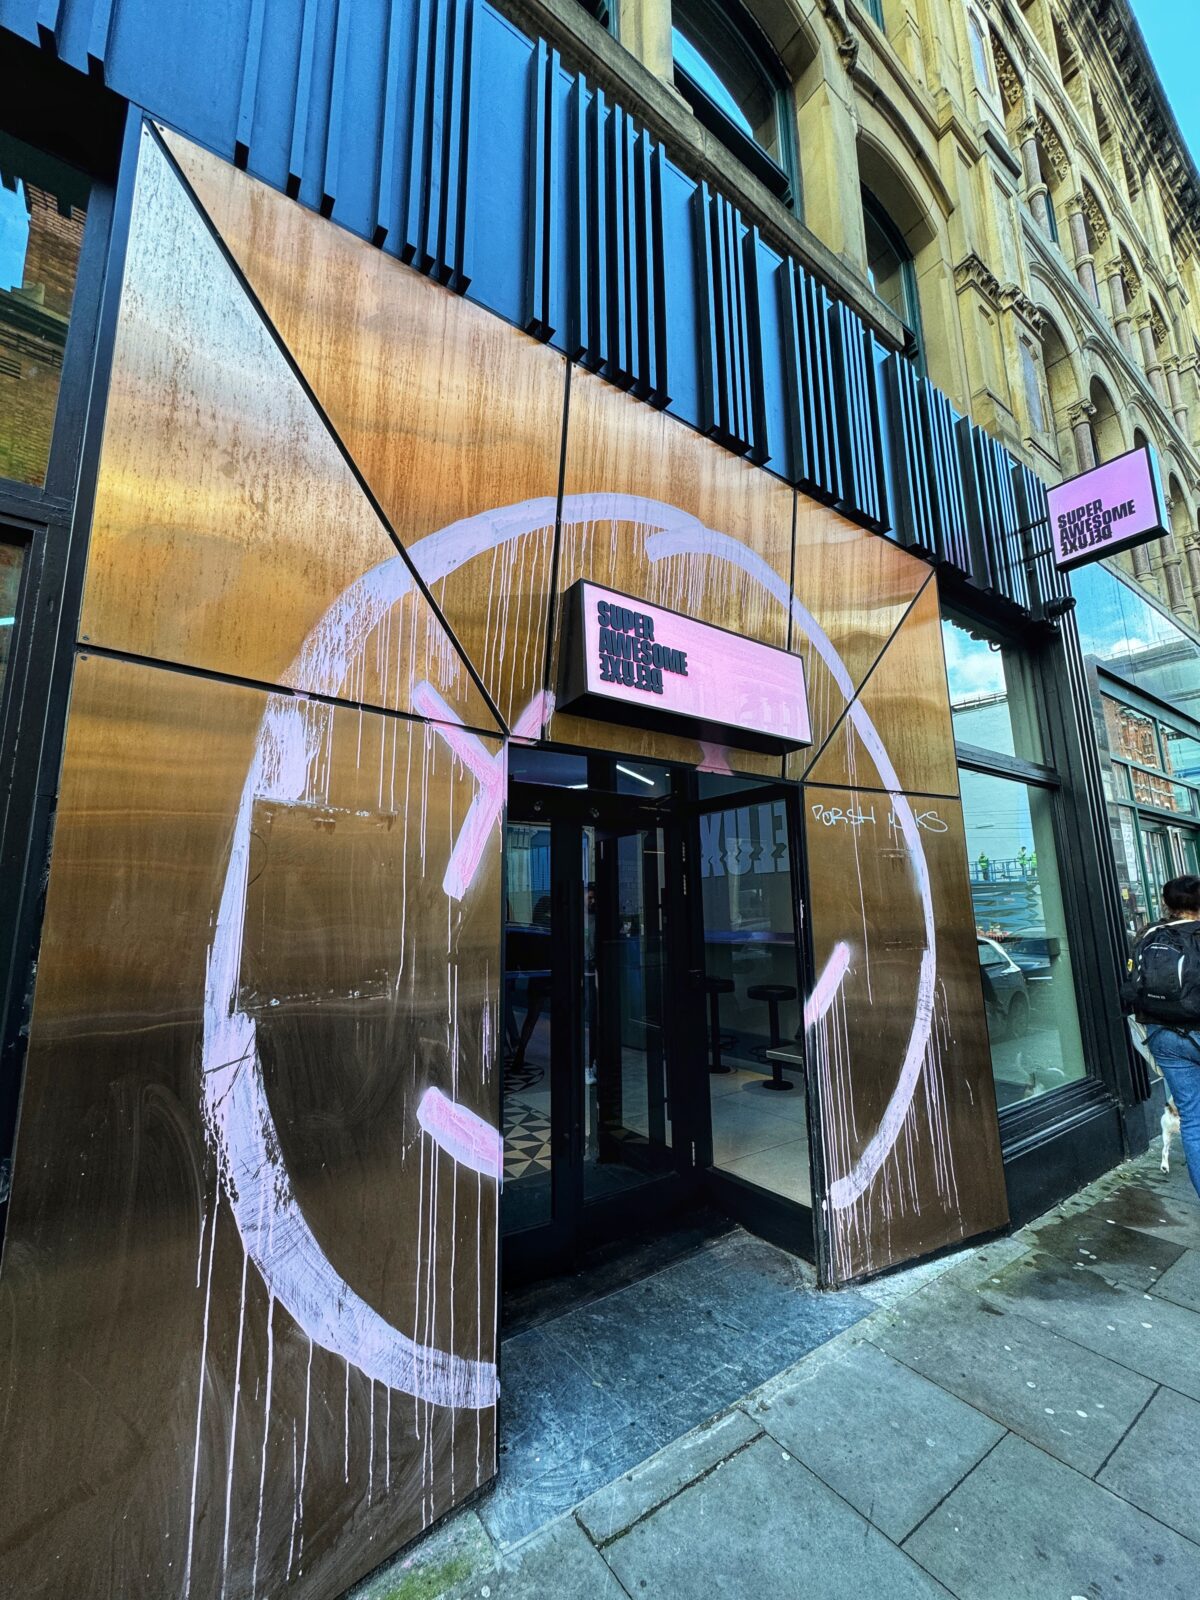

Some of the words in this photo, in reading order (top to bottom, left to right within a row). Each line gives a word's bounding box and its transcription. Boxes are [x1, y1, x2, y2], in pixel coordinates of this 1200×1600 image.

[1057, 498, 1103, 529] SUPER
[1060, 499, 1136, 545] AWESOME
[597, 600, 655, 642] SUPER
[599, 627, 688, 676] AWESOME
